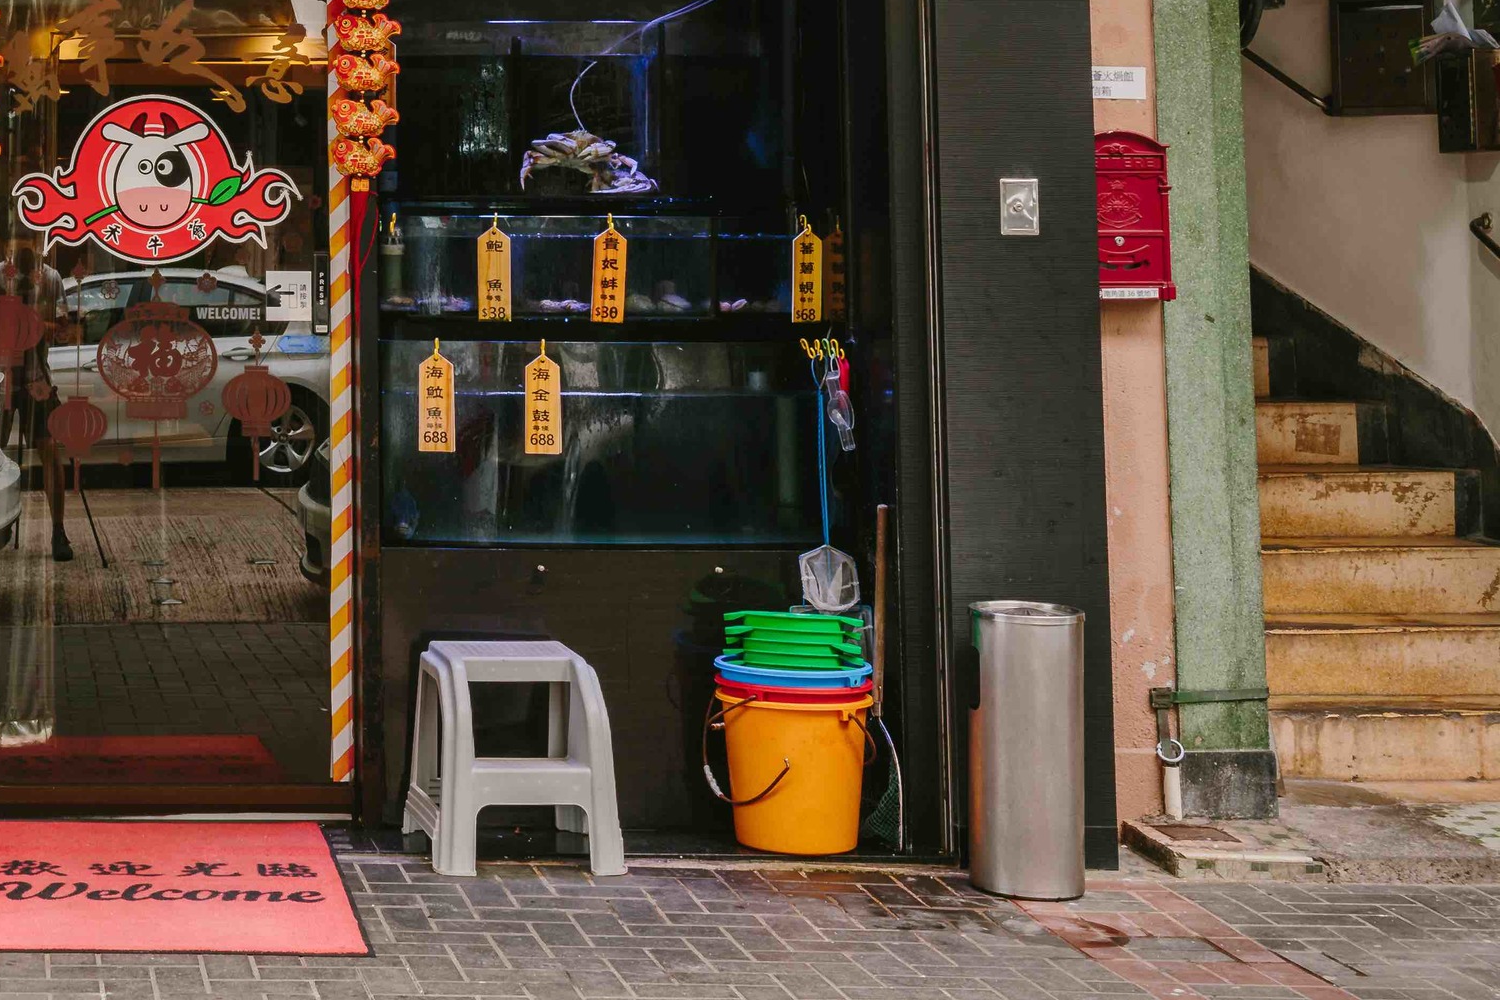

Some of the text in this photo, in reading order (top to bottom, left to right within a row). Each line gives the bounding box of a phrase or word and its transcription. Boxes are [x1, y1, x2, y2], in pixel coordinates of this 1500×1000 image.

[485, 240, 504, 292] 鮑魚
[601, 237, 620, 290] 貴妃蚌
[197, 307, 261, 320] WELCOME!
[481, 306, 506, 320] $38
[795, 308, 816, 321] $68
[532, 368, 550, 423] 海金鼓
[423, 431, 448, 444] 688
[530, 433, 555, 446] 688
